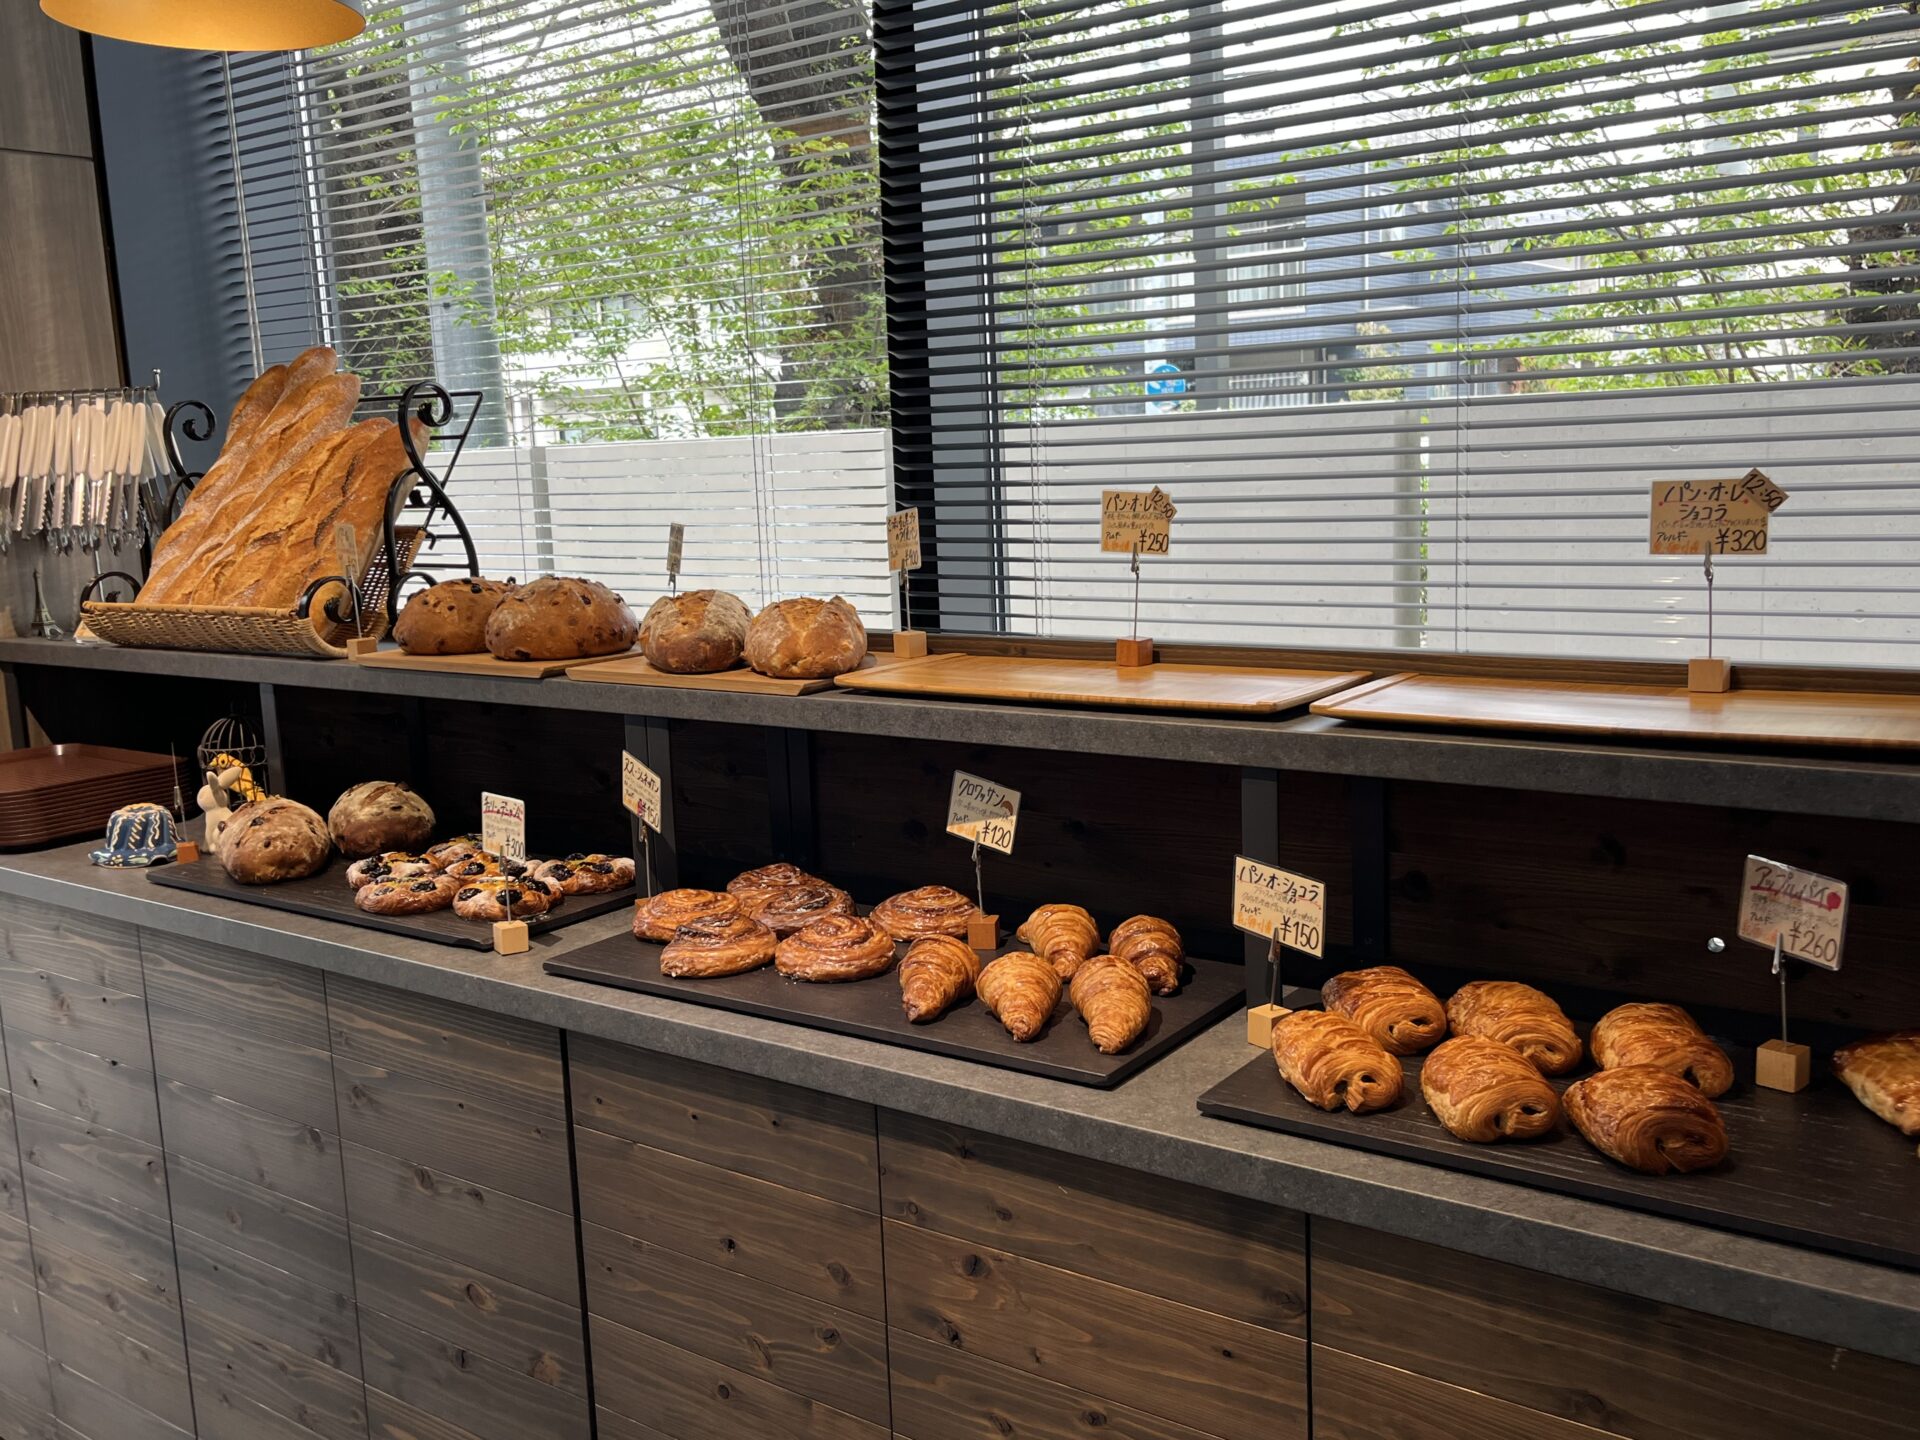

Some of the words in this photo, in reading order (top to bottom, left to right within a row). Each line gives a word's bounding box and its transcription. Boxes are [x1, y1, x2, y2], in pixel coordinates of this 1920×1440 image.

[1741, 473, 1784, 510] 12:50
[1679, 504, 1727, 521] ショコラ
[1139, 529, 1169, 553] ¥250
[1715, 527, 1766, 554] ¥320
[959, 779, 1006, 807] クロワッサン
[505, 834, 525, 860] ¥300
[982, 820, 1012, 849] ¥120
[1240, 865, 1319, 902] パン・オ・ショコラ
[1755, 866, 1830, 906] アップルパイ
[1280, 915, 1319, 950] ¥150
[1789, 920, 1838, 962] ¥260
